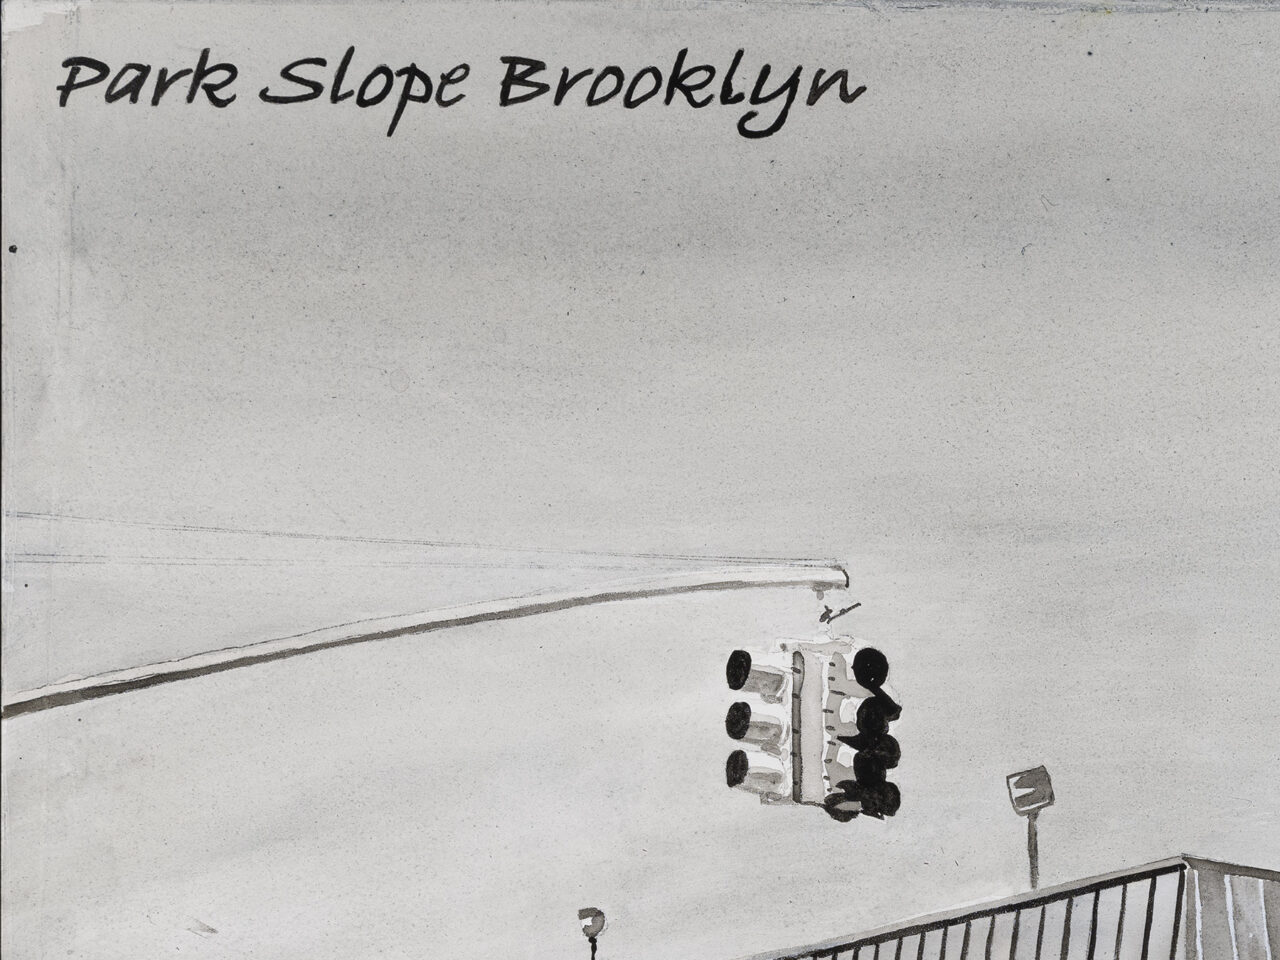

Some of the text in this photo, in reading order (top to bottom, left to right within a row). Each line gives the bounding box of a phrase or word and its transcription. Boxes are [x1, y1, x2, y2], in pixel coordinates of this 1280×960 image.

[56, 46, 868, 140] Park Slope Brooklyn
